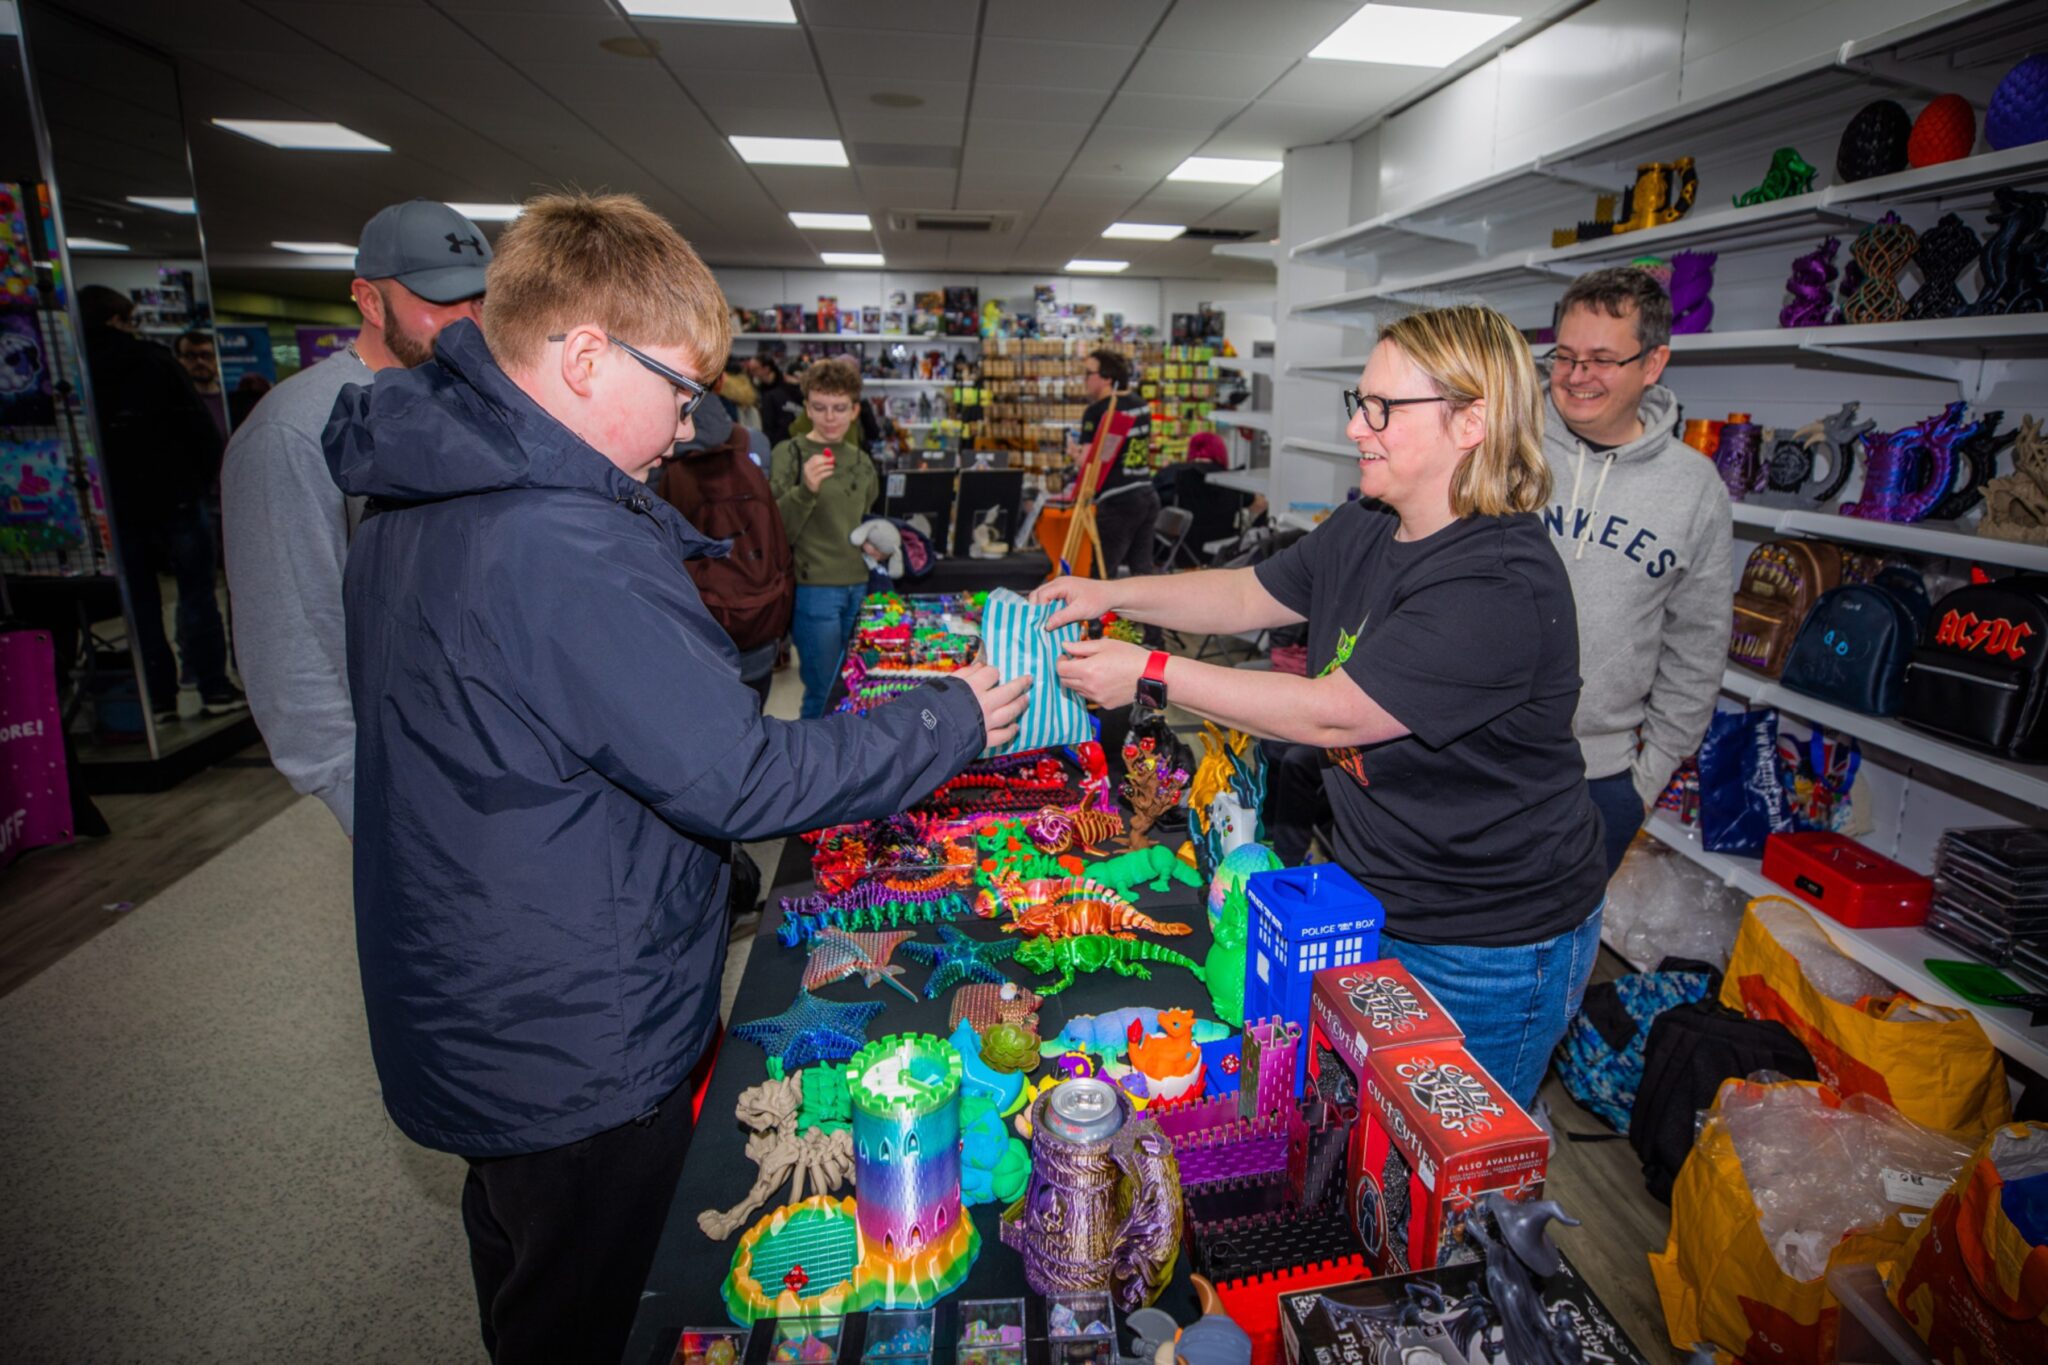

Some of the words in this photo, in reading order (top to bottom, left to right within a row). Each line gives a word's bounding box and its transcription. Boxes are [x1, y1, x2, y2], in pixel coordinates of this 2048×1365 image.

[1935, 608, 2033, 661] AC/DC
[1301, 924, 1336, 937] POLICE
[1355, 918, 1376, 930] BOX
[1457, 1161, 1483, 1172] ALSO
